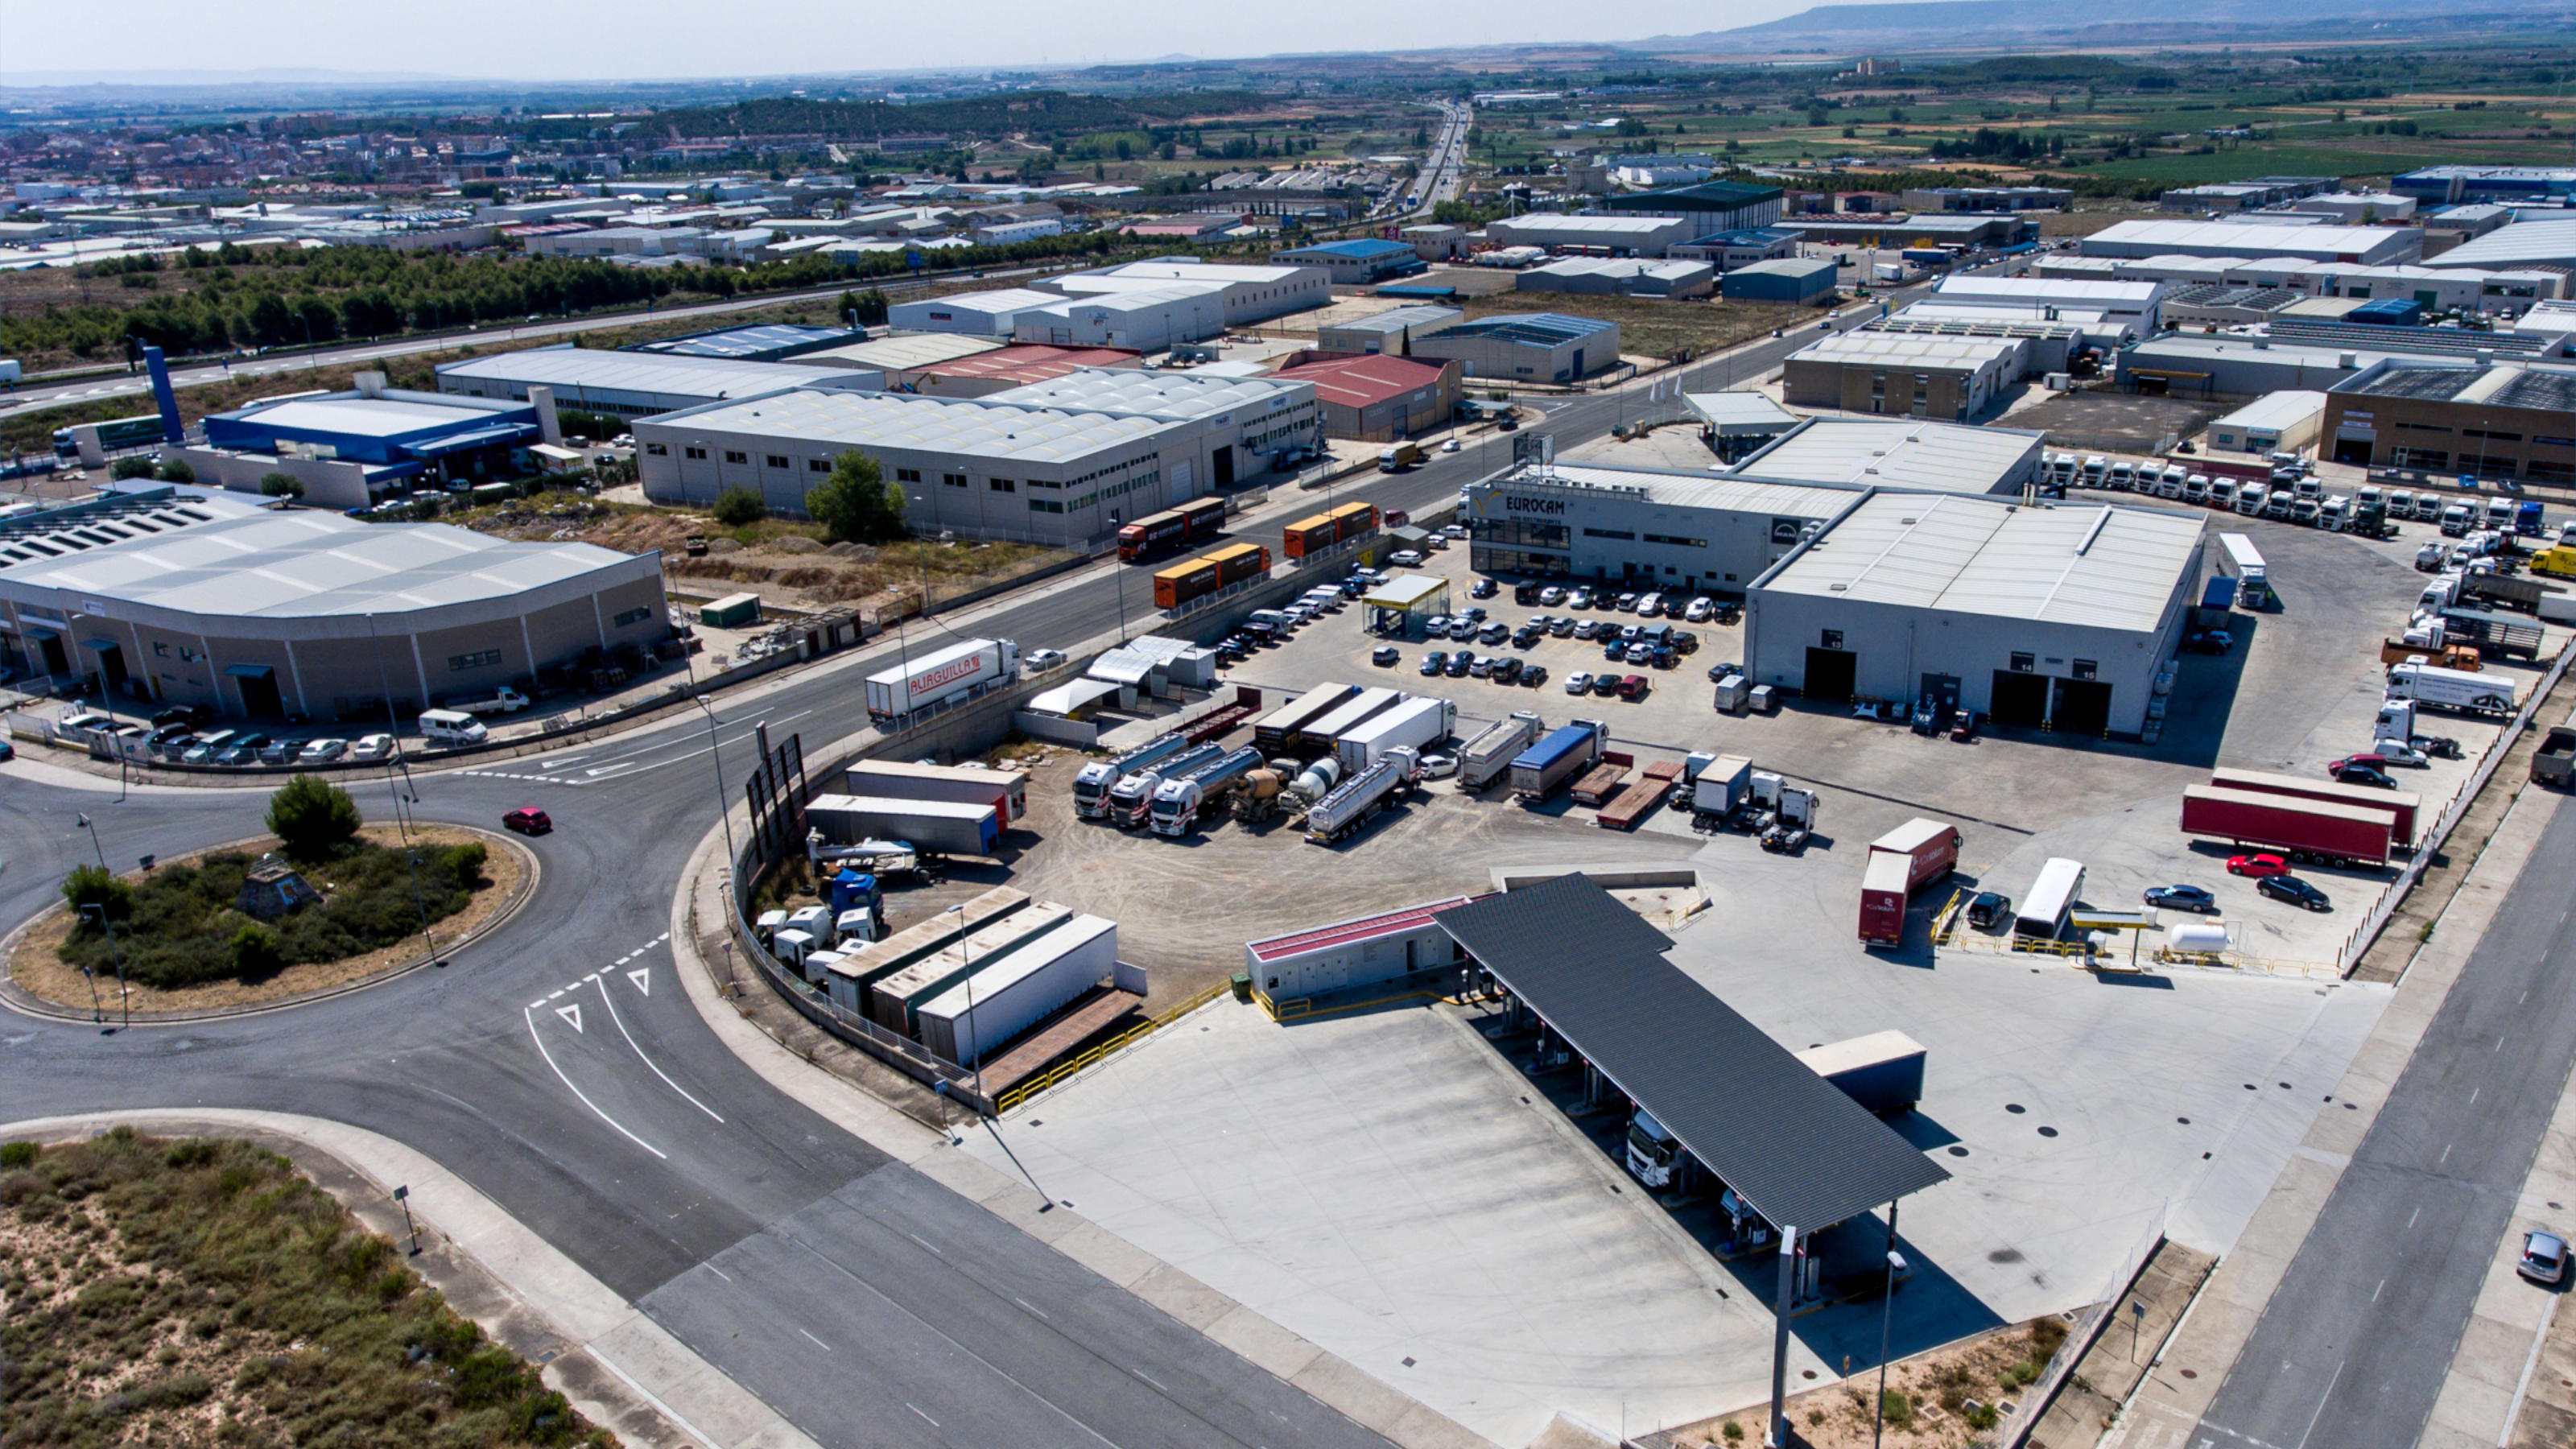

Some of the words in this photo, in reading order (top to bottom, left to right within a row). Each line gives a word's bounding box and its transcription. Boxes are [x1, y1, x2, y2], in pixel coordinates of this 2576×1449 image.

[1506, 495, 1565, 515] EUROCAM
[910, 658, 971, 693] ALIAGUILLA
[2021, 663, 2033, 671] 14
